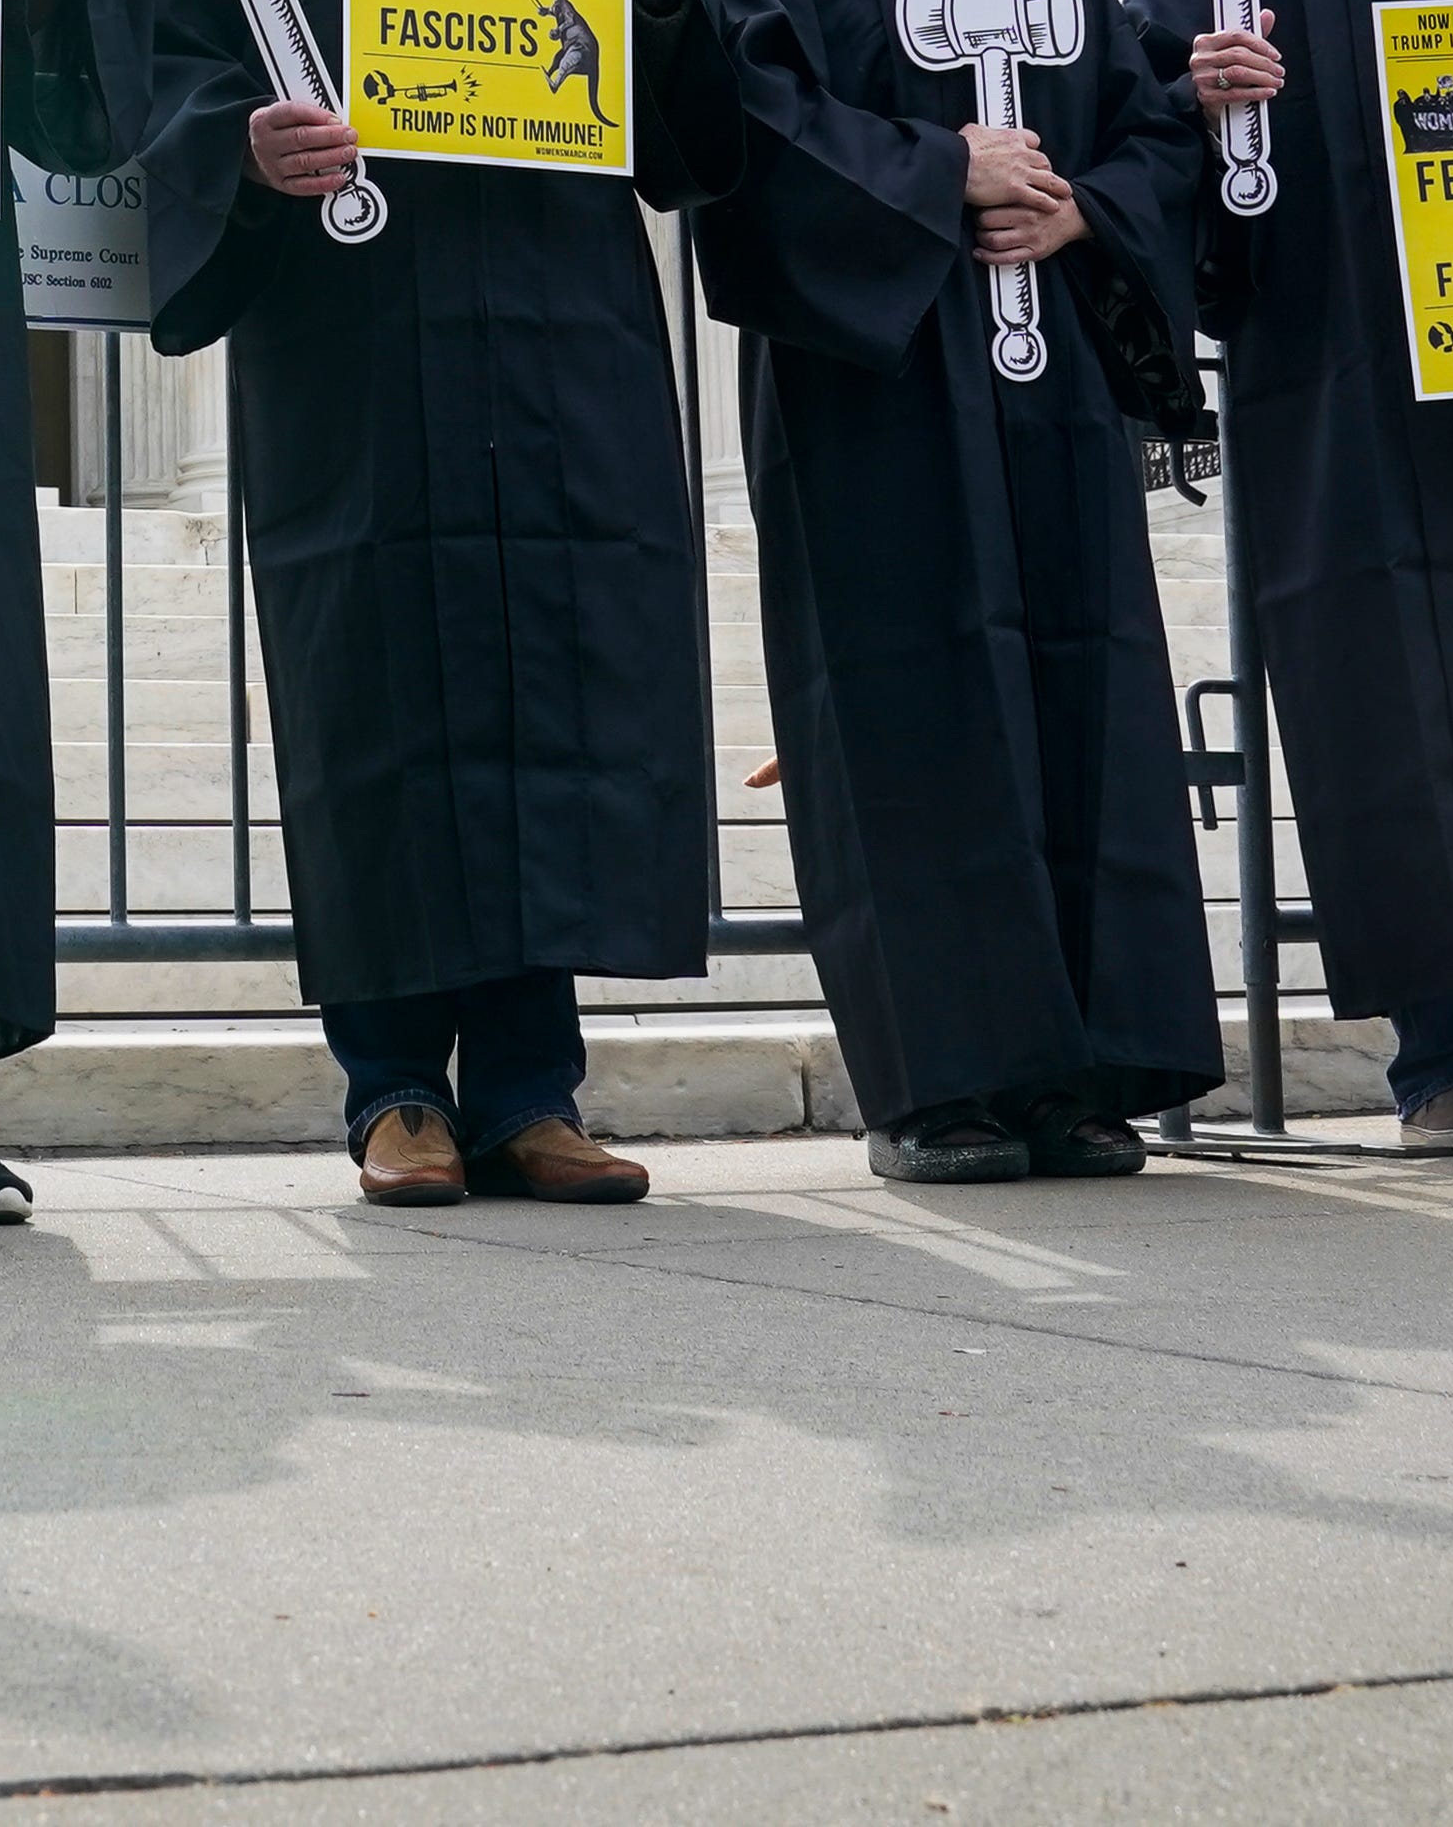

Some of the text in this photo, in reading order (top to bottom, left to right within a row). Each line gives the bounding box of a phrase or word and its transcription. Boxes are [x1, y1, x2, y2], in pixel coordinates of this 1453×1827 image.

[1418, 13, 1449, 30] NOW
[381, 8, 537, 57] FASCISTS
[1391, 34, 1442, 50] TRUMP
[391, 108, 602, 147] TRUMP IS NOT IMMUNE!
[45, 172, 147, 209] CLOS
[31, 245, 93, 263] Supreme
[99, 248, 139, 264] Court
[47, 274, 86, 287] Section
[90, 277, 112, 289] 6102
